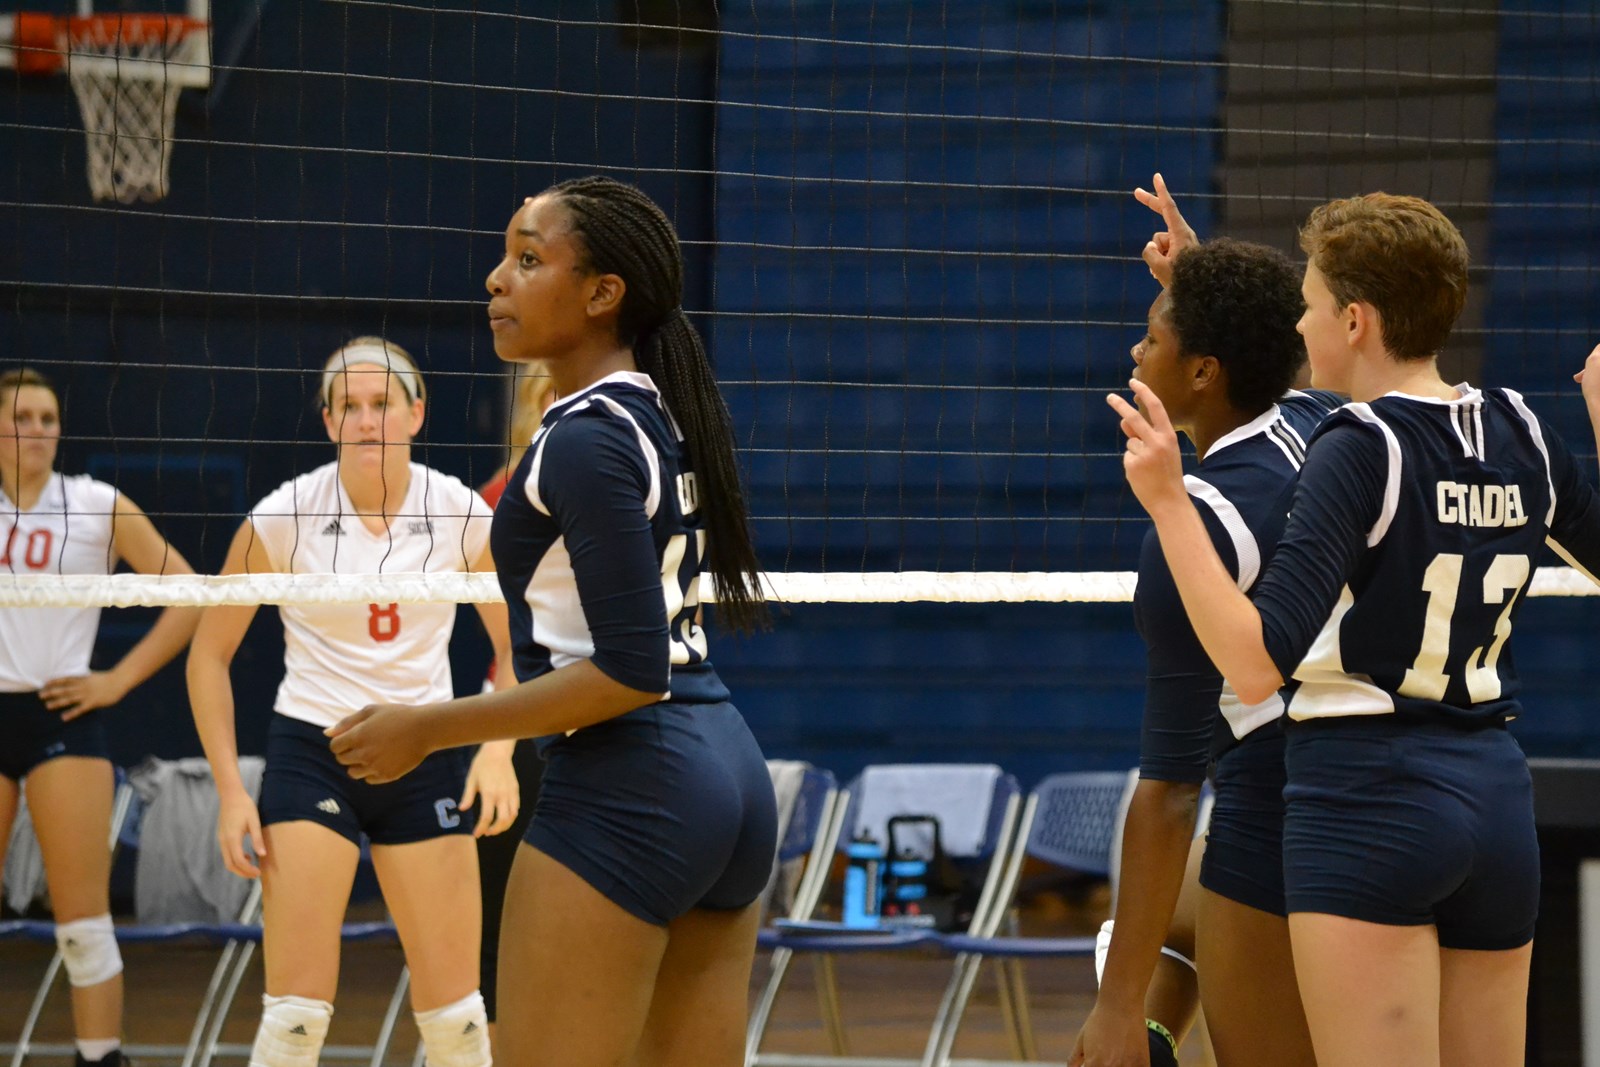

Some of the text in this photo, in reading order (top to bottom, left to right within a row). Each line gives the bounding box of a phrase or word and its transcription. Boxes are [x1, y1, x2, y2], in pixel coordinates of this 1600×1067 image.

[0, 526, 52, 570] 10
[369, 602, 400, 642] 8
[1397, 552, 1530, 704] 13
[433, 796, 461, 829] C
